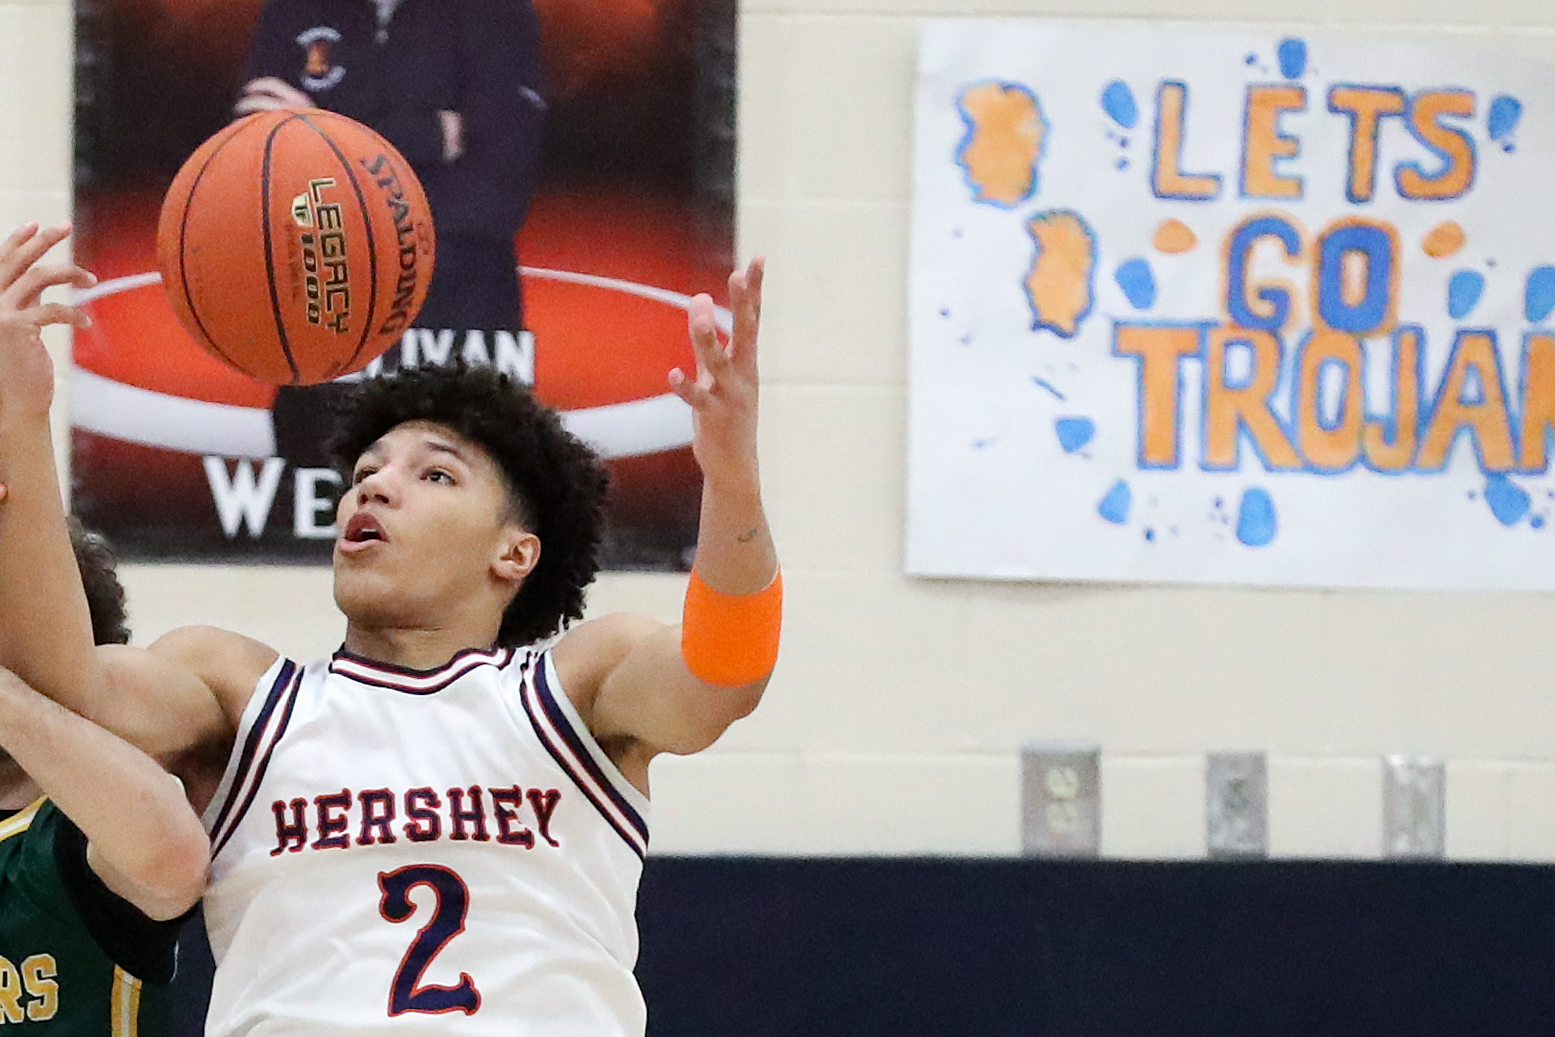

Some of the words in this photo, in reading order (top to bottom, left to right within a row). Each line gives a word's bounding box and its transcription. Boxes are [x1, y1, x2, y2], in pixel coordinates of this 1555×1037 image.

[1151, 80, 1478, 203] LETS
[301, 231, 321, 325] 1000
[308, 176, 352, 335] LEGACY
[361, 154, 418, 335] SPALDING
[1222, 210, 1401, 338] GO
[270, 785, 562, 856] HERSHEY
[378, 864, 482, 1017] 2
